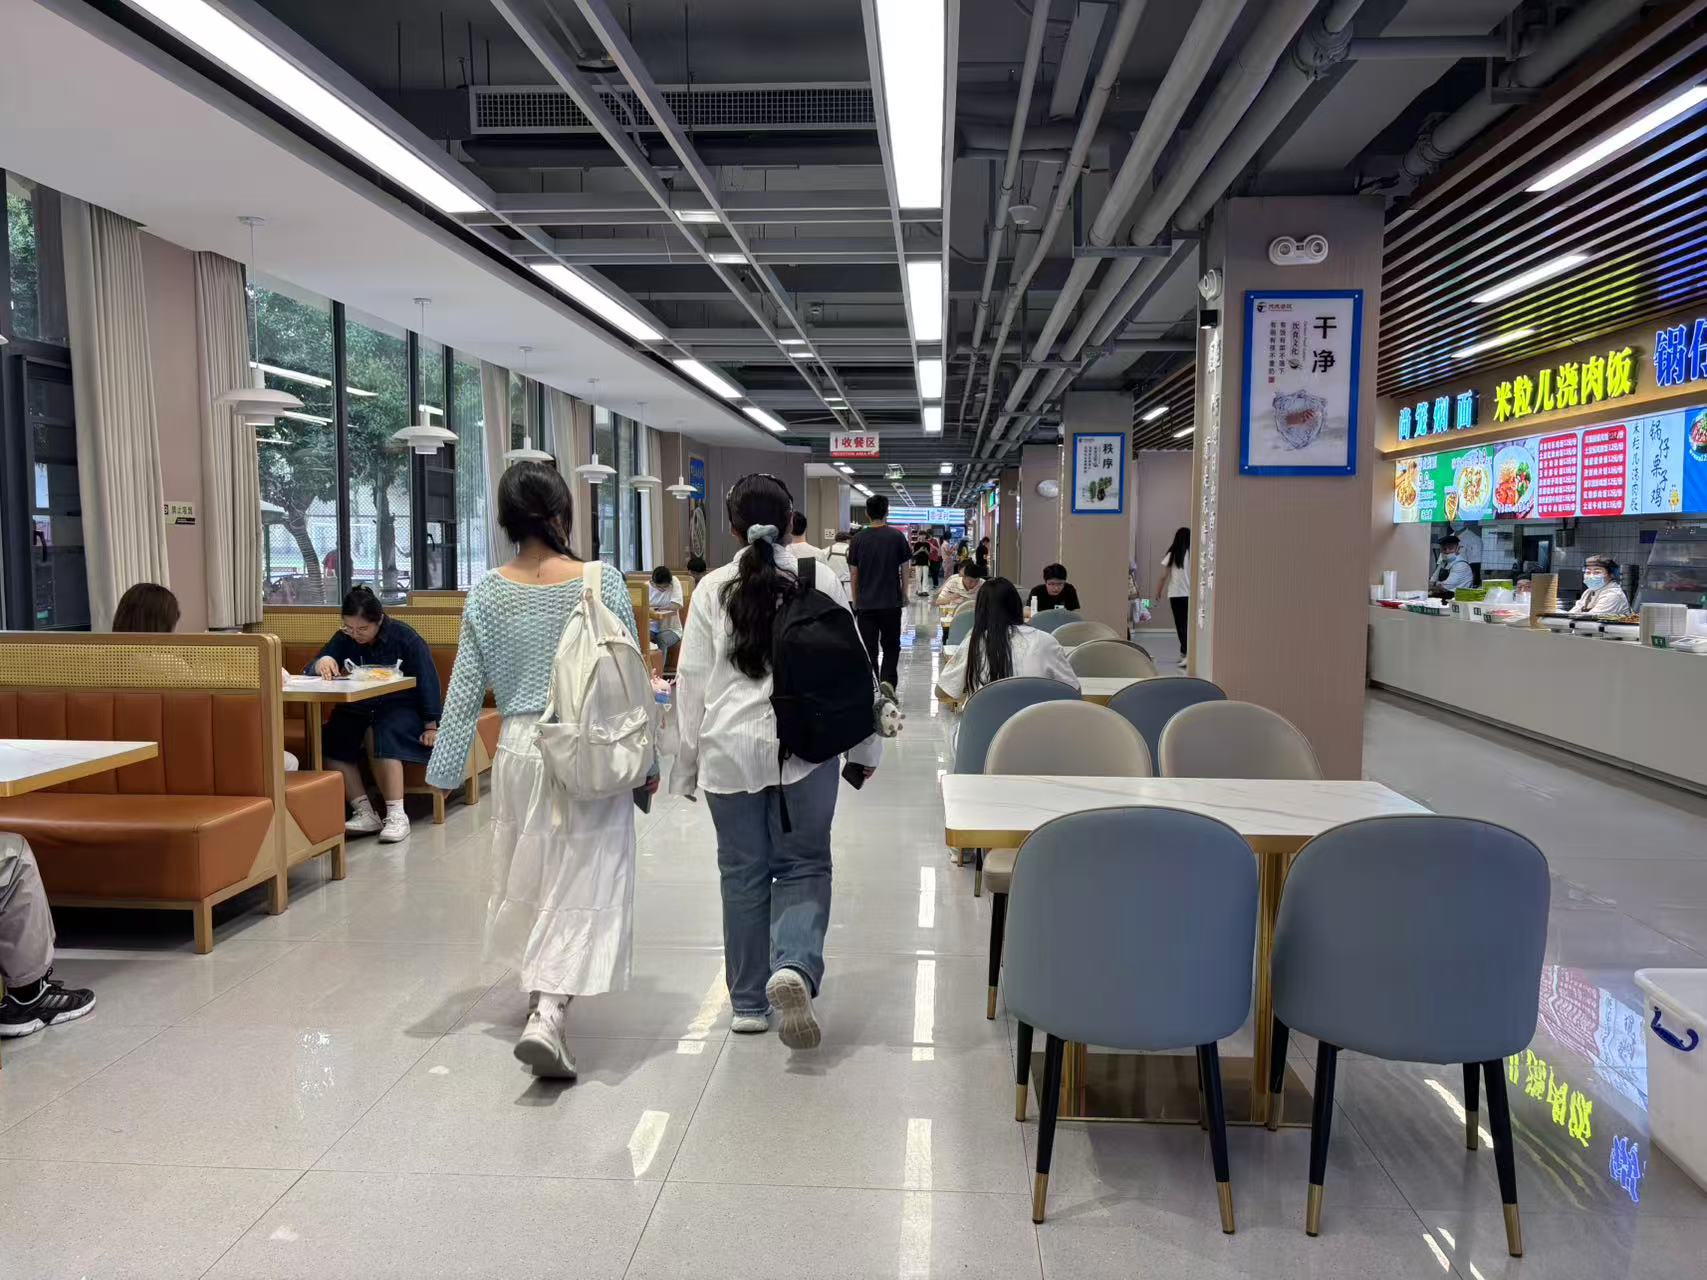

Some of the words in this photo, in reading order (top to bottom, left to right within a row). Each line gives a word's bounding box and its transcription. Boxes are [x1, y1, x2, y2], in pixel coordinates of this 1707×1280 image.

[1291, 322, 1300, 356] 饮食文化
[1312, 316, 1337, 374] 干净
[1494, 346, 1634, 423] 米粒儿浇肉饭
[841, 436, 875, 448] 收餐区
[1103, 443, 1113, 469] 秩序
[1649, 419, 1671, 509] 锅仔栗子鸡
